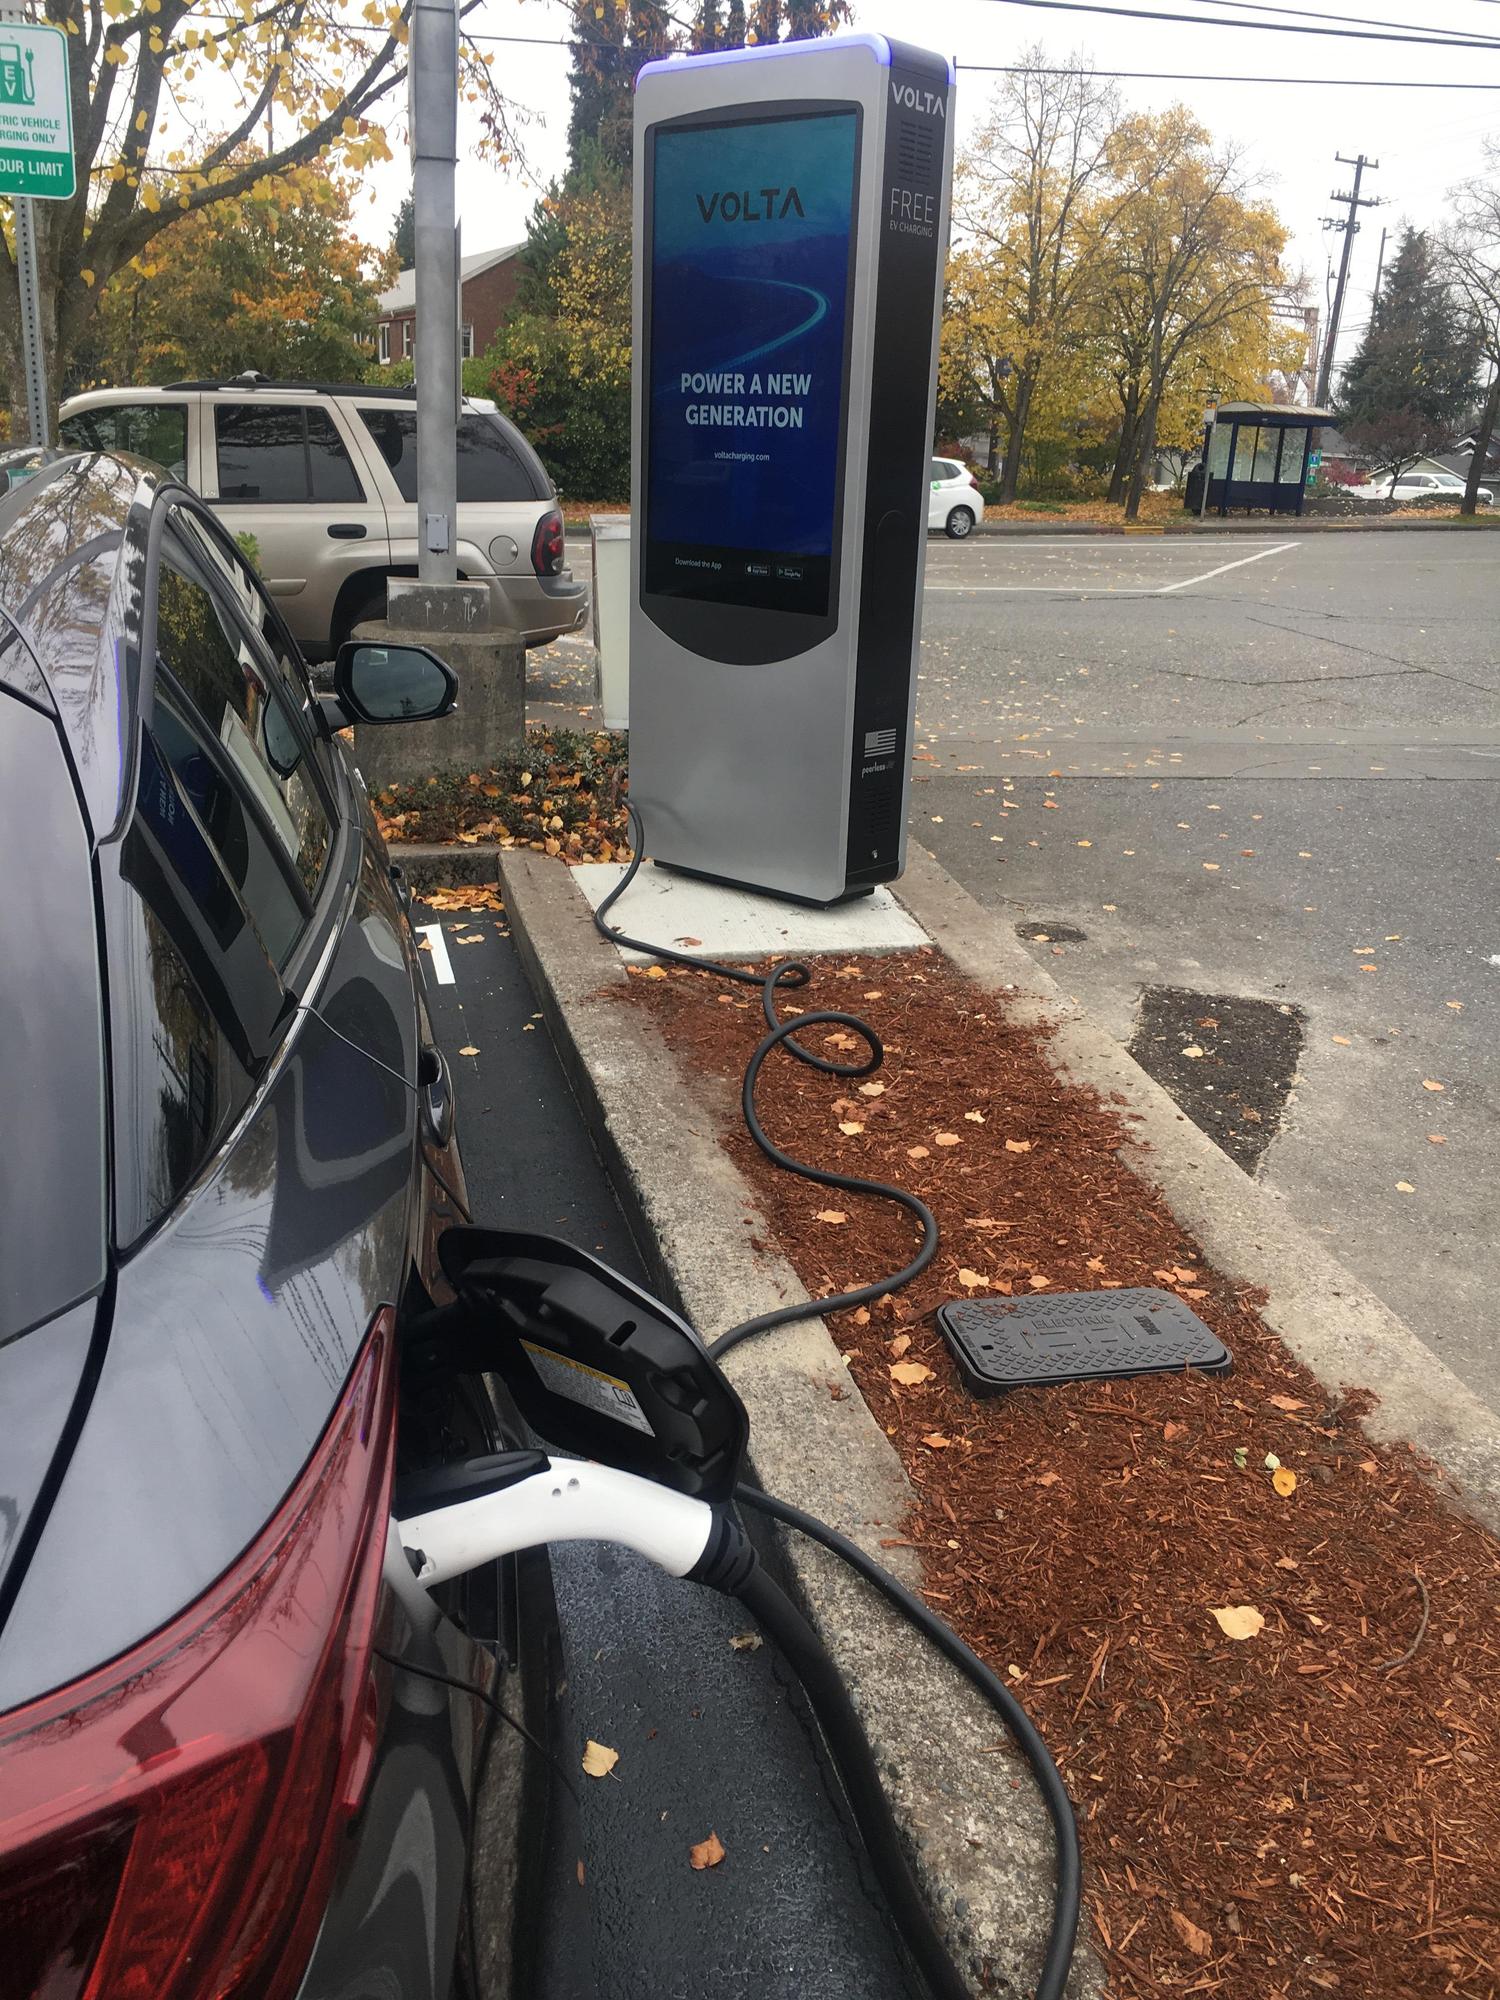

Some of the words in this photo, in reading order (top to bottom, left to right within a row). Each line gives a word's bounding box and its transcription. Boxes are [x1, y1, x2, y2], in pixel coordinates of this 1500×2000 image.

[891, 82, 945, 118] VOLTA
[21, 117, 61, 129] VEHICLE
[32, 132, 56, 144] ONLY
[28, 160, 65, 177] LIMIT
[696, 187, 805, 224] VOLTA
[890, 188, 934, 223] FREE
[889, 220, 898, 231] EV
[900, 221, 933, 238] CHARGING
[681, 372, 745, 395] POWER
[749, 373, 763, 395] A
[767, 373, 812, 396] NEW
[685, 404, 803, 428] GENERATION
[675, 557, 701, 567] Download
[702, 560, 710, 568] the
[711, 561, 722, 570] App
[1031, 1314, 1116, 1330] ELECTRIC
